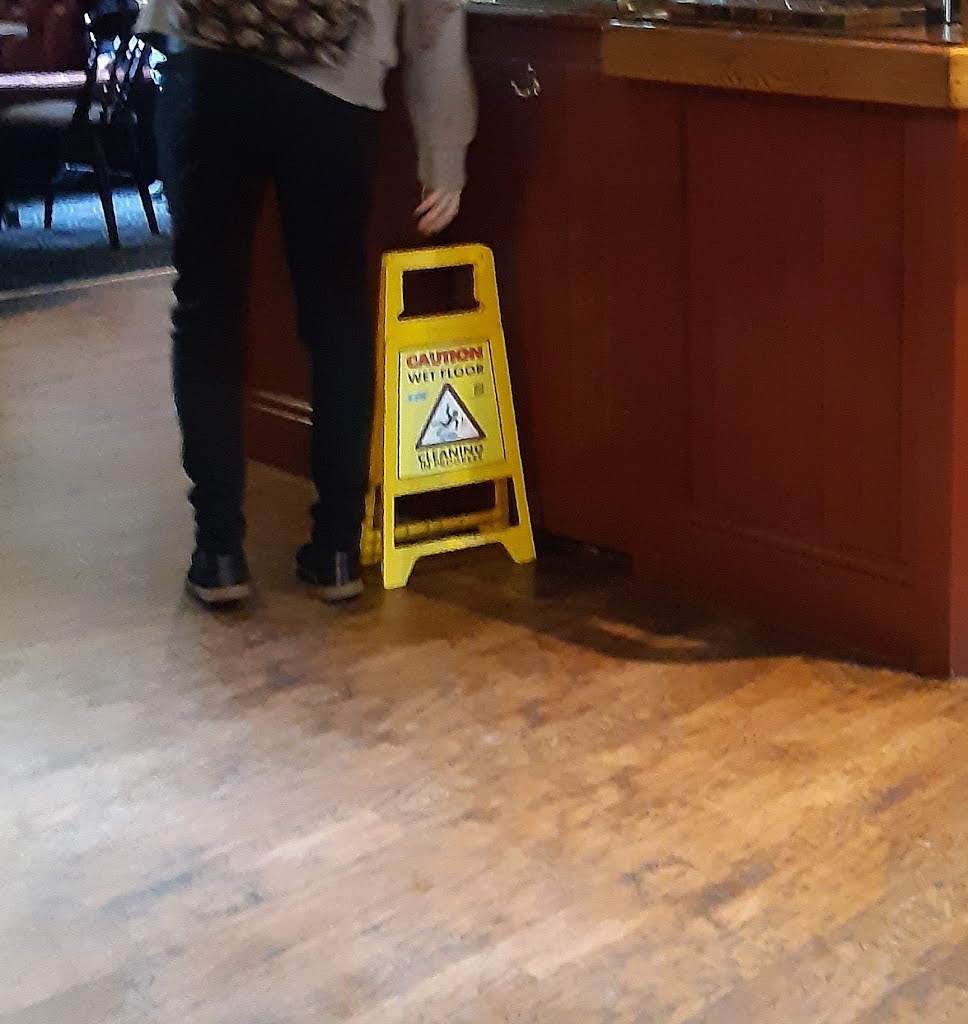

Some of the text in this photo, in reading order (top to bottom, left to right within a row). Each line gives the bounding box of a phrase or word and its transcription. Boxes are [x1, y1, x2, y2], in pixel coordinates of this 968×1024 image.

[406, 346, 483, 369] CAUTION
[408, 364, 485, 383] WET FLOOR
